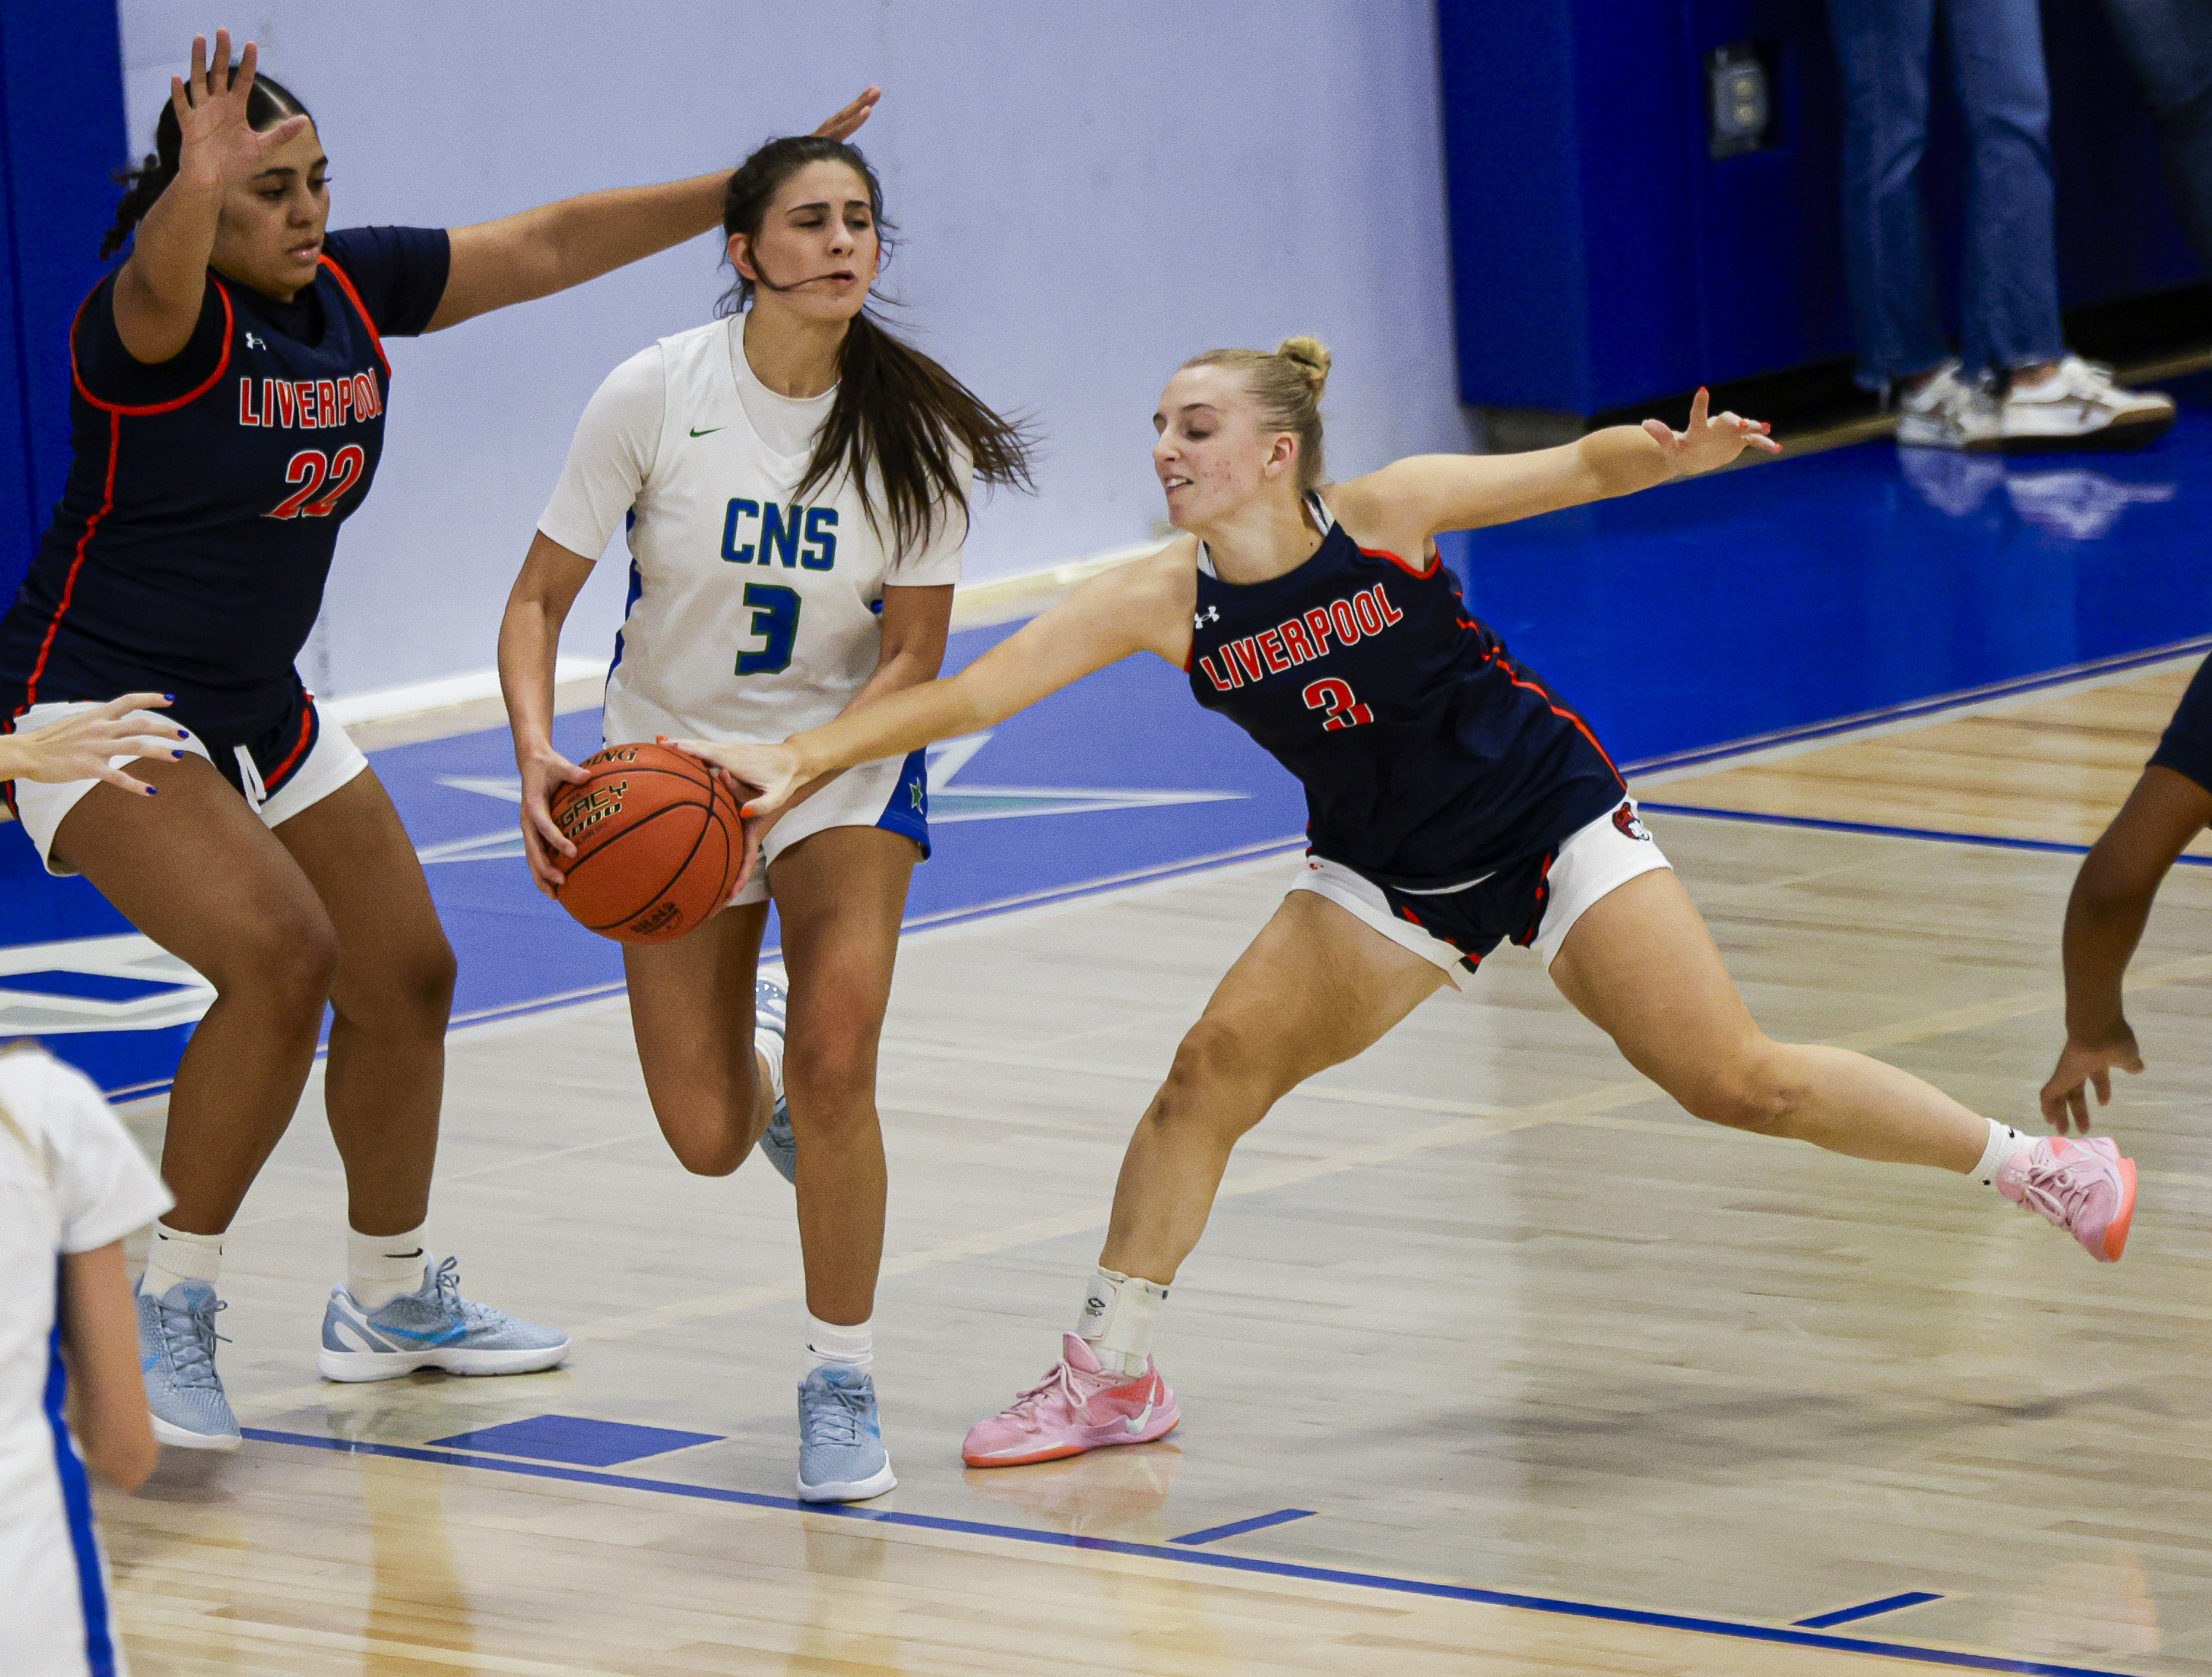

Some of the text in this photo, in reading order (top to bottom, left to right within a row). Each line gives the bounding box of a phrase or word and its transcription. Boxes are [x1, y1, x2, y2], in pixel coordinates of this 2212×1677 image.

[262, 445, 365, 520] 22
[720, 497, 839, 571] CNS
[734, 582, 802, 676] 3
[1199, 583, 1403, 692] LIVERPOOL
[1302, 676, 1374, 732] 3
[558, 779, 628, 829] GACY
